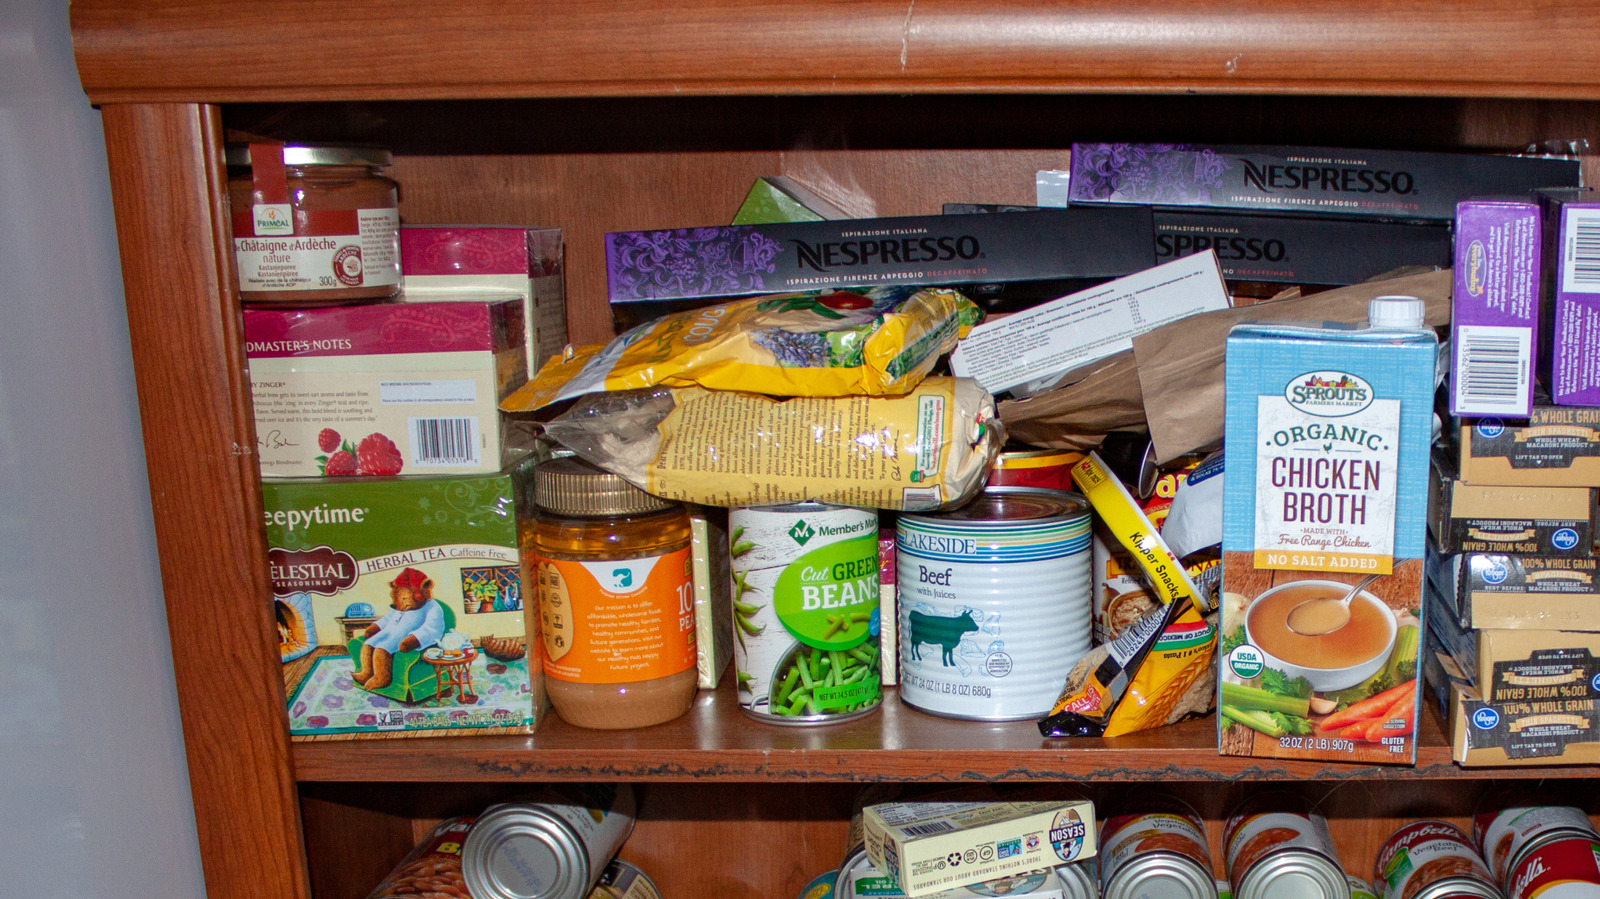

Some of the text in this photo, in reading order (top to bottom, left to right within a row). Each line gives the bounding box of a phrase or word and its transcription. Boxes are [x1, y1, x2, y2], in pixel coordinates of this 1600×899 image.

[1287, 156, 1367, 166] ISPIRAZIONE ITALIANA
[1236, 157, 1414, 195] NESPRESSO
[1231, 196, 1420, 210] ISPIRAZIONE FIRENZE ARPEGGIO DECAFFEINATO
[842, 230, 890, 238] ISPIRAZIONE
[1159, 225, 1240, 234] ISPIRAZIONE ITALIANA
[241, 238, 336, 254] Châtaigne d'Ardèche
[788, 235, 980, 272] NESPRESSO
[1156, 234, 1286, 262] SPRESSO
[263, 254, 290, 263] nature
[319, 276, 338, 287] 300g
[786, 268, 988, 285] ISPIRAZIONE FIRENZE ARPEGGIO DECAFFEINATO
[245, 339, 352, 353] DMASTER'S NOTES
[1292, 384, 1366, 404] SPROUTS
[1540, 411, 1600, 424] WHOLE GRAI
[1274, 424, 1383, 451] ORGANIC
[1548, 427, 1588, 436] SPAGHETTI
[1272, 457, 1381, 491] CHICKEN
[1283, 492, 1366, 525] BROTH
[264, 503, 365, 530] eepytime
[819, 524, 864, 536] Member's
[904, 530, 976, 554] LAKESIDE
[1278, 534, 1371, 550] Free Range Chicken
[1555, 532, 1576, 545] Kroger
[1463, 542, 1537, 552] 100% WHOLE GRAIN
[366, 548, 507, 572] HERBAL TEA Caffeine Free
[1268, 554, 1377, 569] NO SALT ADDED
[1522, 558, 1596, 569] 100% WHOLE GRAIN
[801, 566, 829, 582] Cut
[919, 565, 952, 586] Beef
[1156, 564, 1179, 599] Snacks
[276, 580, 333, 588] SEASONINGS
[802, 574, 879, 611] BEANS
[917, 587, 956, 600] with Juices
[1237, 653, 1256, 661] USDA
[1514, 675, 1571, 684] SPAGHETTI
[926, 680, 933, 691] OZ
[935, 681, 940, 692] (1
[942, 683, 950, 694] LB
[952, 684, 956, 695] 8
[959, 684, 970, 696] OZ)
[972, 686, 991, 698] 680g
[1496, 685, 1587, 700] 100% WHOLE GRAIN
[1064, 697, 1089, 712] CALL
[1504, 700, 1594, 715] 100% WHOLE GRAIN
[1477, 711, 1496, 726] Kroger
[1541, 716, 1579, 725] SPAGHETTI
[1280, 737, 1353, 752] 32 OZ (2 LB) 907g
[1381, 737, 1404, 745] GLUTEN
[1389, 745, 1404, 753] FREE
[1050, 824, 1084, 842] SEASON
[913, 856, 1041, 890] THERE'S NOTHING STANDARD ABOUT OUR STANDARDS
[1512, 857, 1547, 899] bell's
